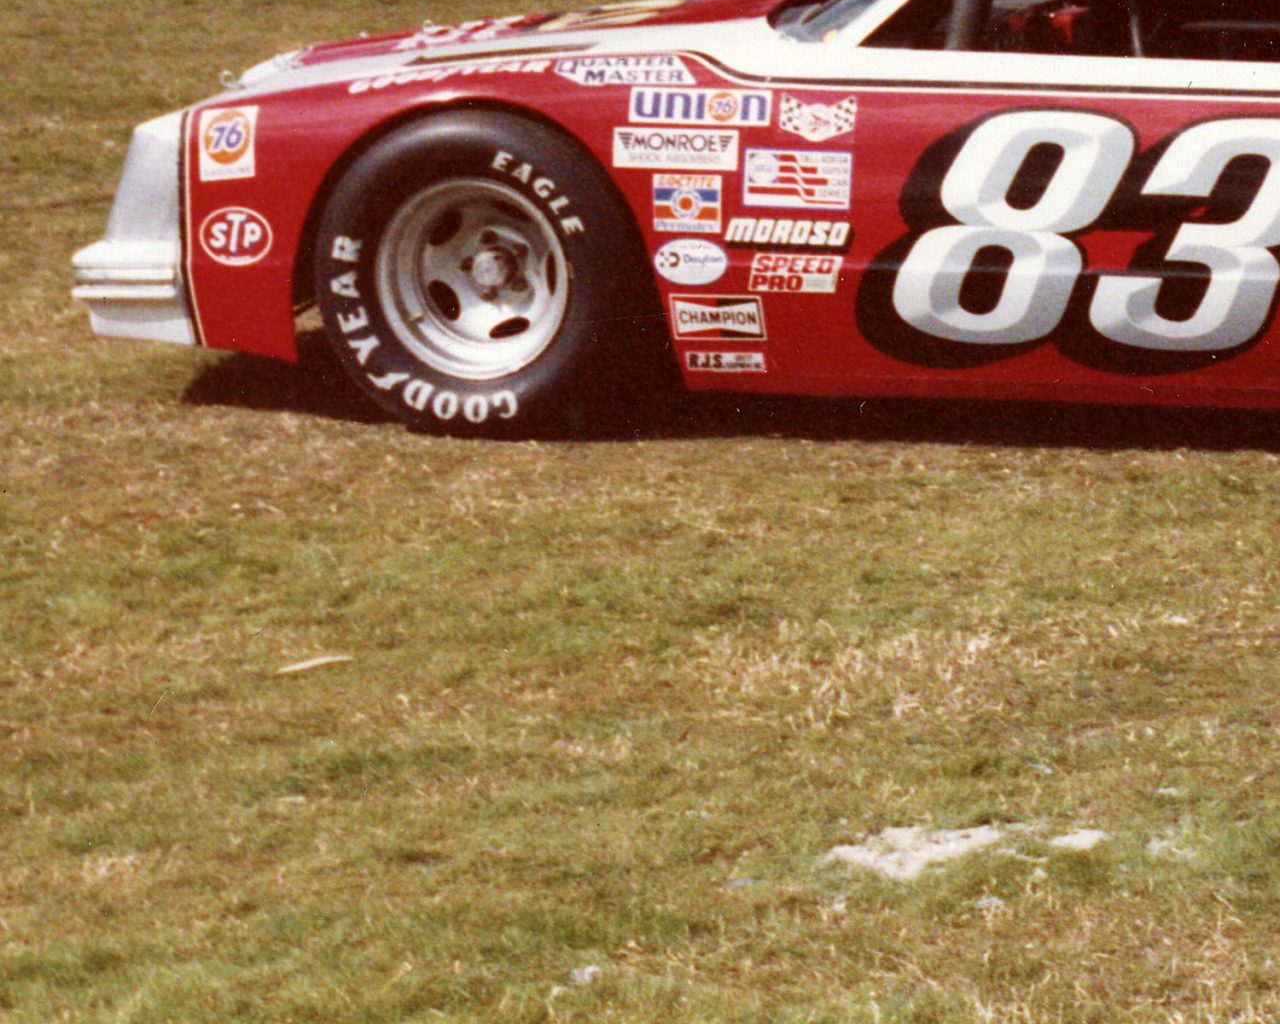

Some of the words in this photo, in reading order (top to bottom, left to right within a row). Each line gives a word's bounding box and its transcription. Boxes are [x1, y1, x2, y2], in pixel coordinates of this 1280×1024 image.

[584, 69, 685, 83] MASTER
[210, 120, 244, 152] 76
[632, 132, 719, 152] MONROE
[490, 149, 586, 236] EAGLE
[208, 212, 263, 253] STP
[724, 217, 852, 247] MOROSO
[754, 254, 836, 274] SPEED
[750, 274, 804, 291] PRO
[330, 235, 519, 424] GOODYEAR
[678, 310, 757, 325] CHAMPION
